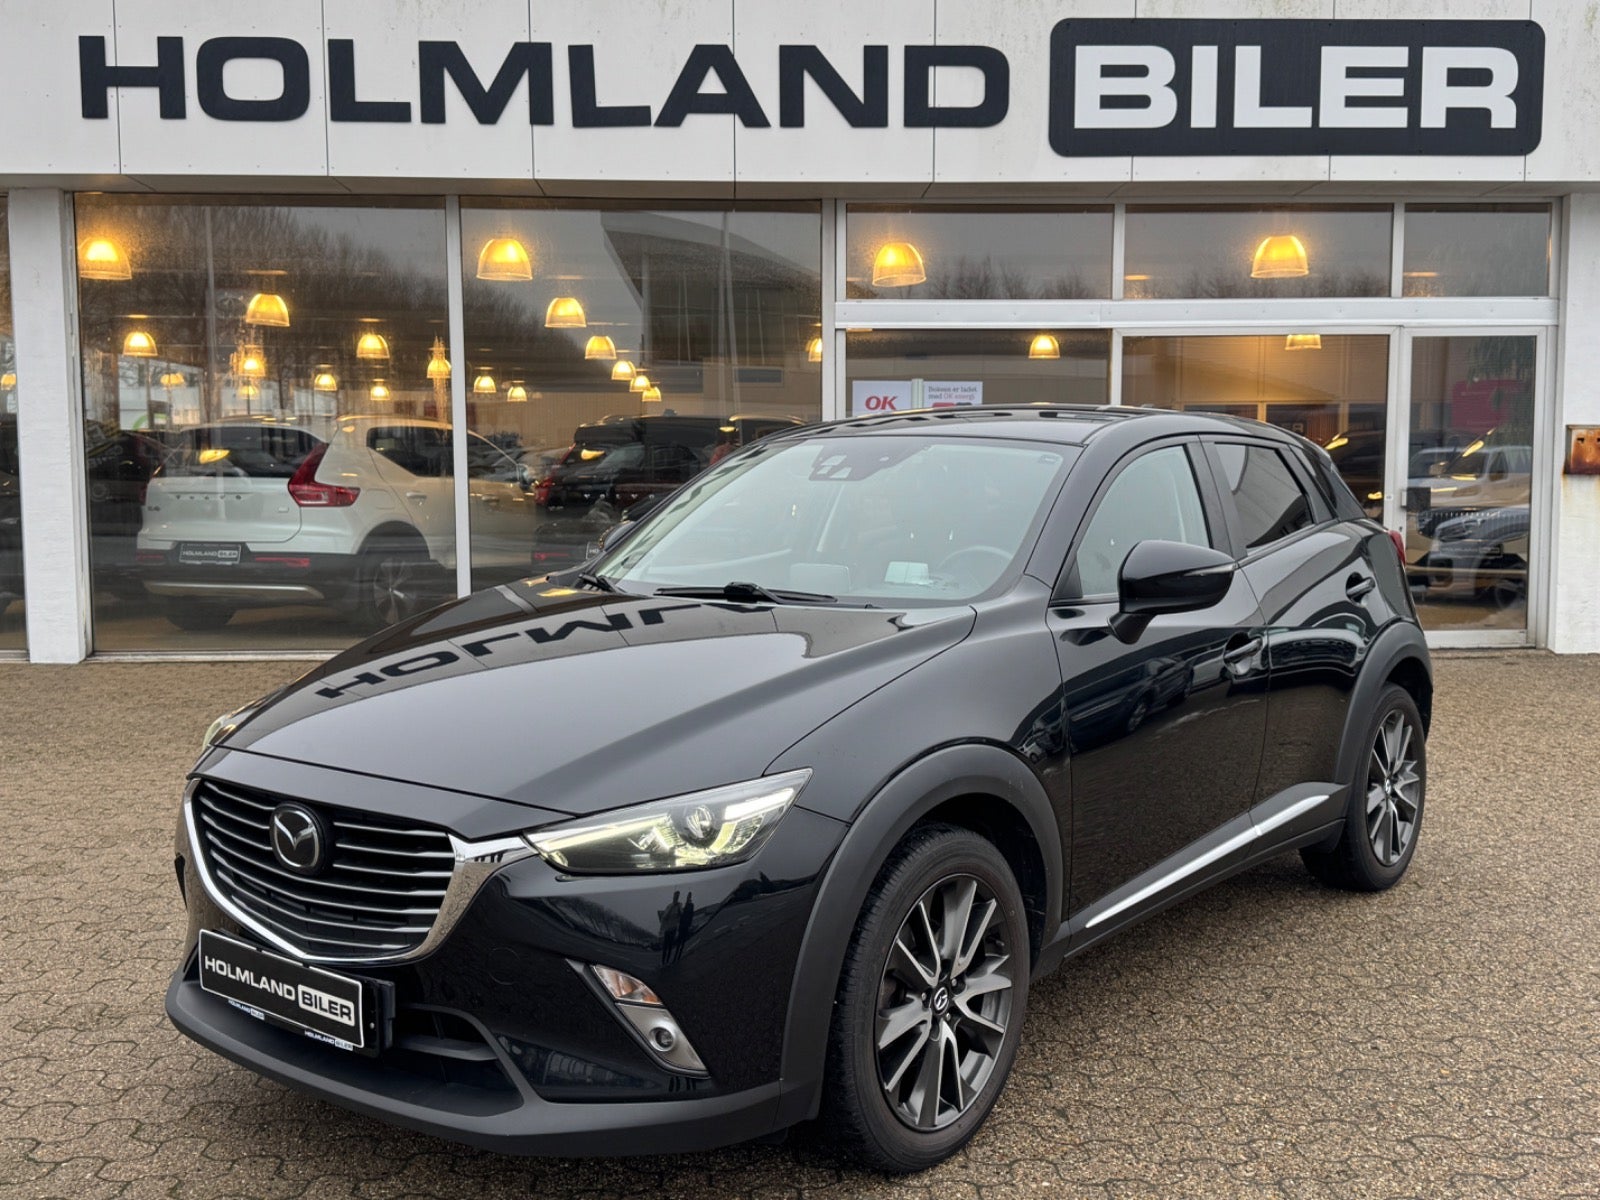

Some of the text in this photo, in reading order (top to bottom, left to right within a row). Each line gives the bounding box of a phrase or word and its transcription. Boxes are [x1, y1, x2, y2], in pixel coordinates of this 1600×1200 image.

[78, 35, 1519, 129] HOLMLAND BILER
[865, 395, 898, 411] OK
[204, 955, 352, 1021] HOLMLAND BILER
